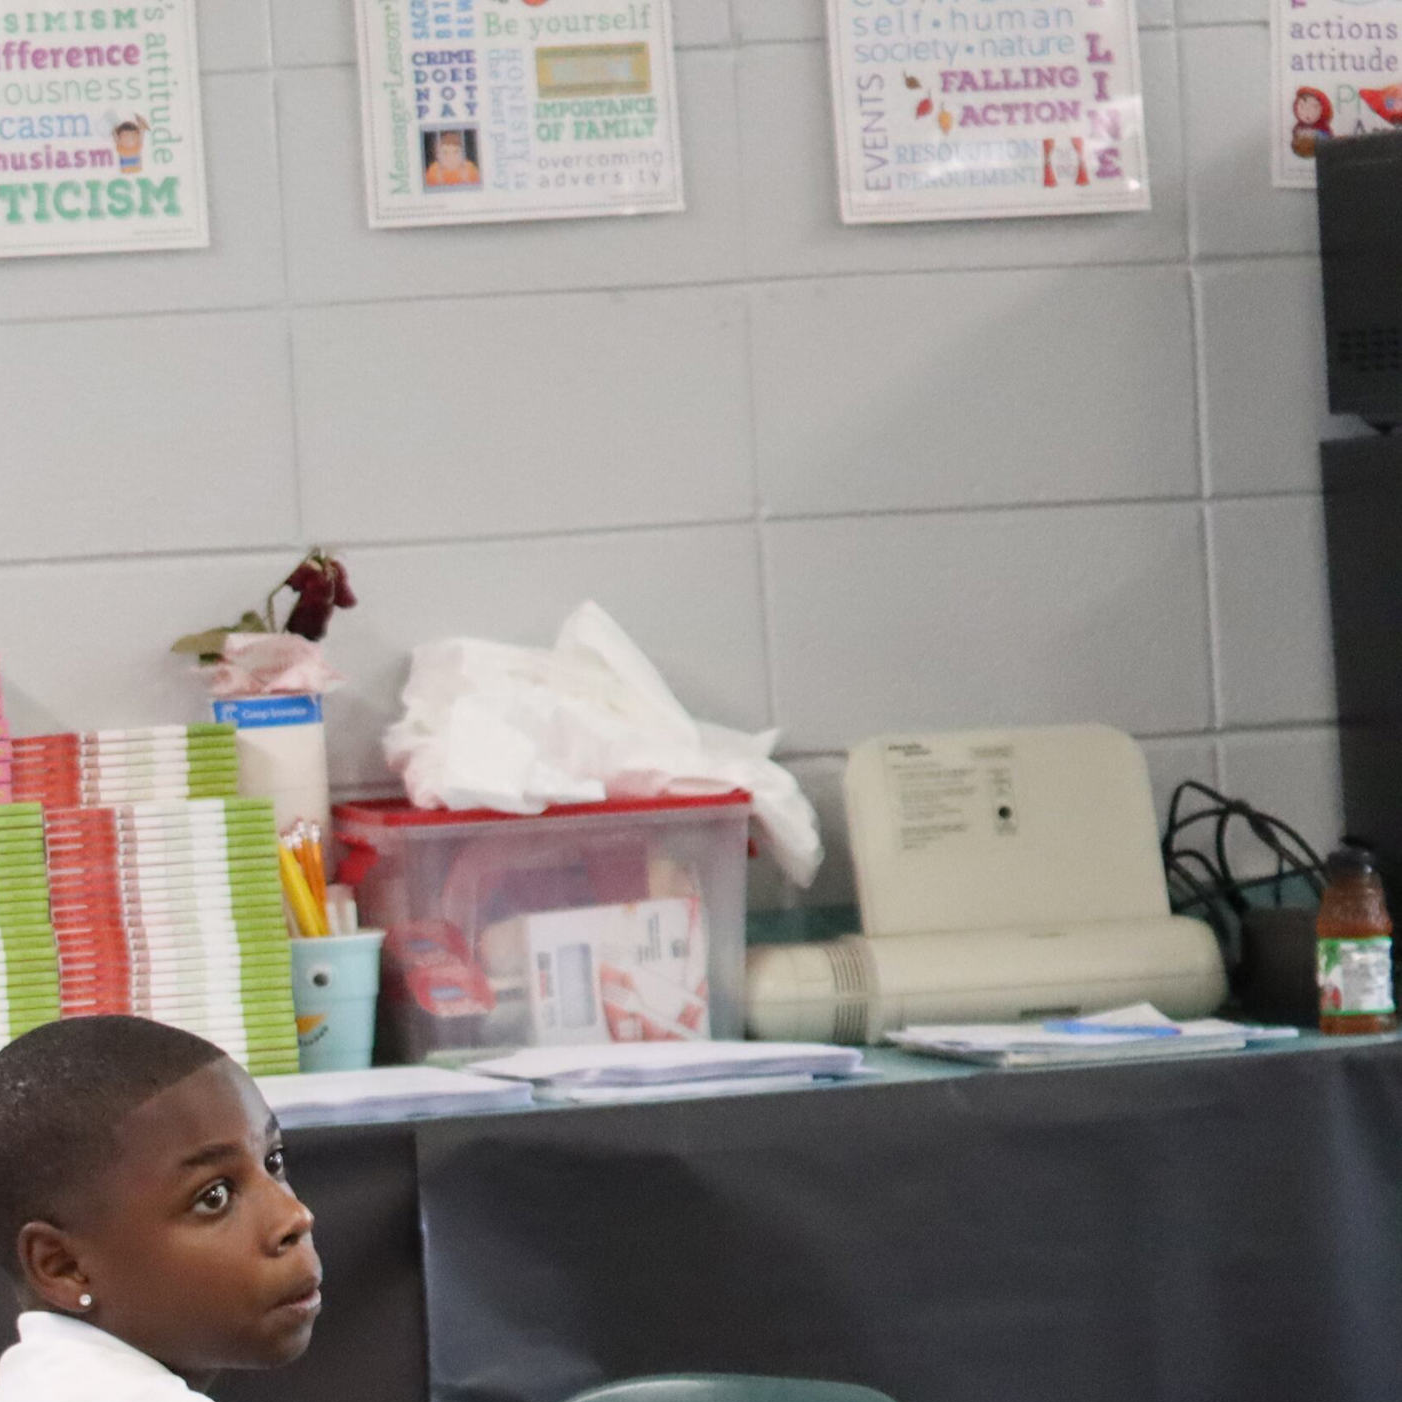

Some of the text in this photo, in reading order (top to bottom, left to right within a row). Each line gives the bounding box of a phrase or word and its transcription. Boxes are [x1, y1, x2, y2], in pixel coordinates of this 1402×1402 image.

[484, 4, 651, 40] Be yourself
[852, 8, 1074, 37] self human
[1290, 16, 1397, 39] actions
[412, 50, 476, 66] CRIME
[854, 33, 1074, 64] society nature
[1291, 47, 1397, 72] attitude
[414, 68, 476, 84] DOES
[939, 66, 1080, 93] FALLING
[146, 32, 182, 164] attitude
[415, 86, 478, 101] NOT
[416, 102, 478, 119] PAY
[535, 96, 657, 118] IMPORTANCE
[959, 100, 1081, 127] ACTION
[536, 118, 657, 142] OF FAMILY
[857, 72, 891, 191] EVENTS
